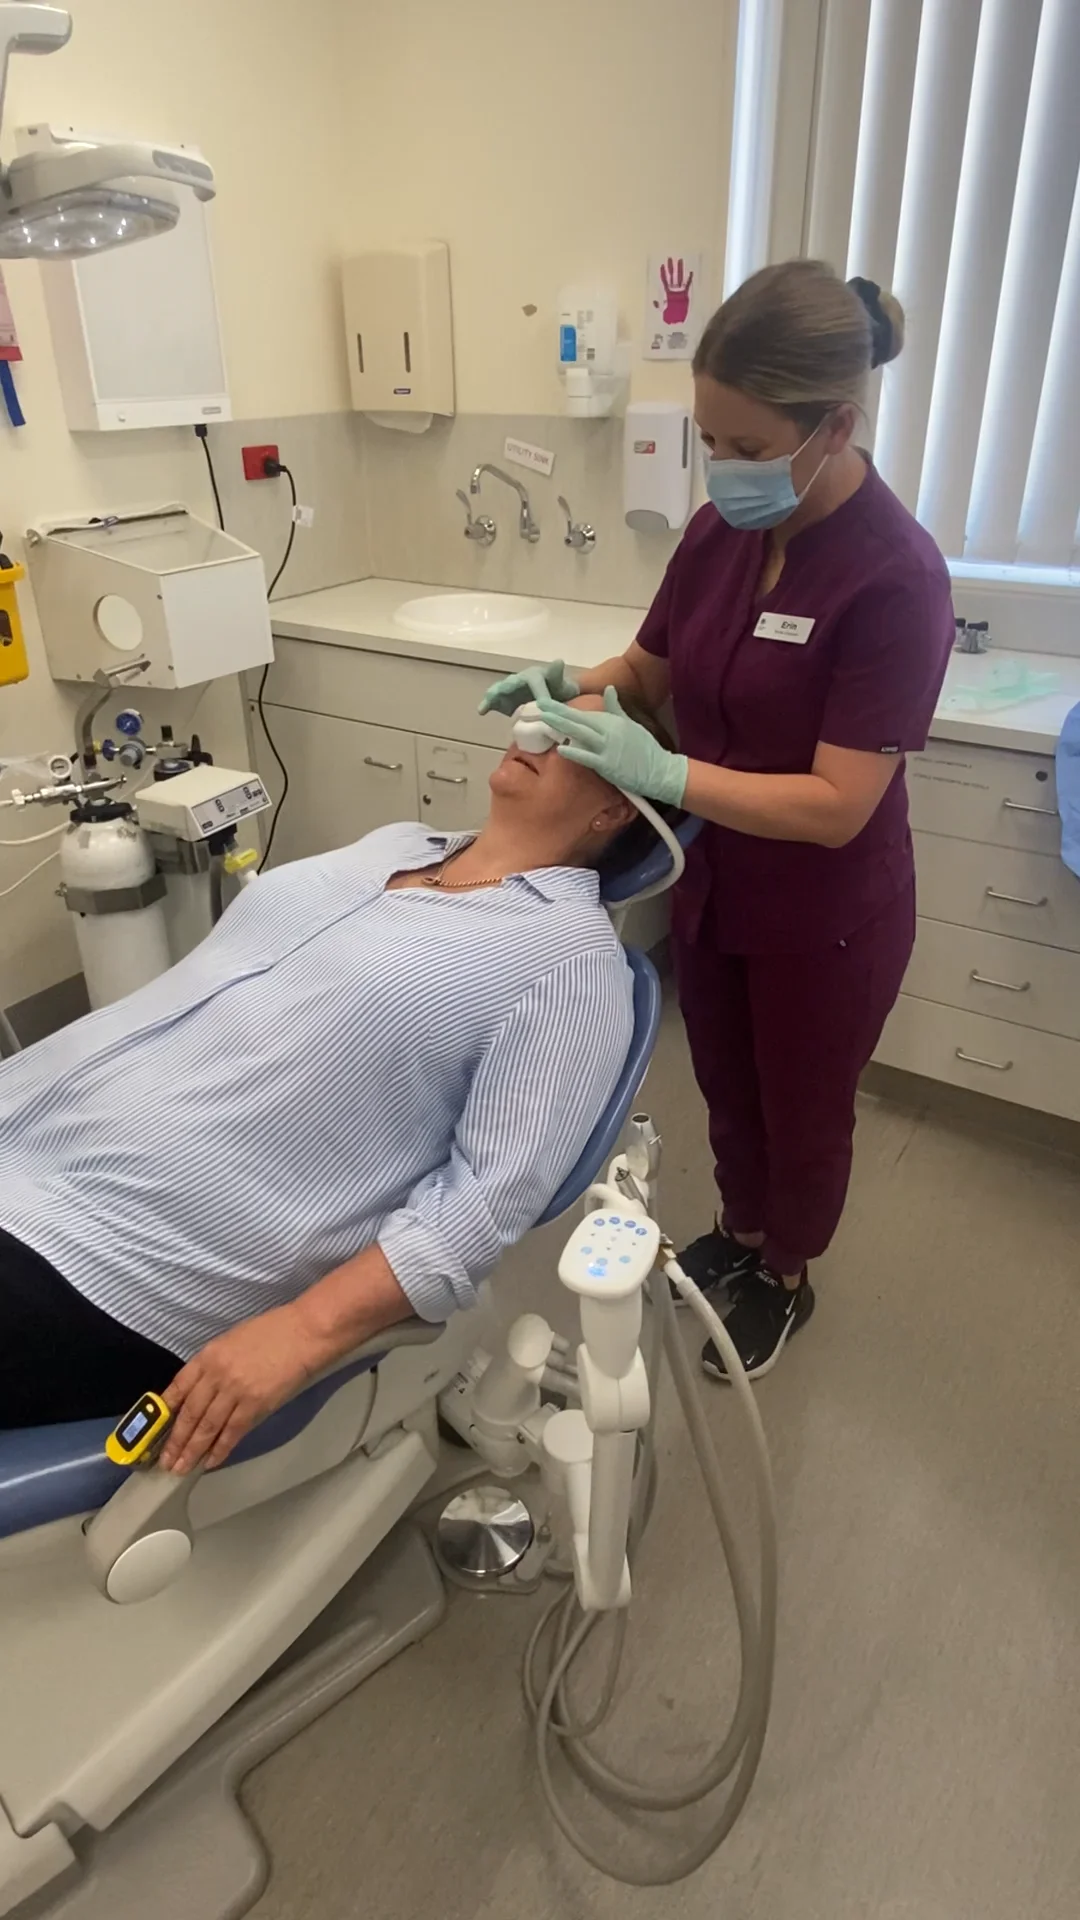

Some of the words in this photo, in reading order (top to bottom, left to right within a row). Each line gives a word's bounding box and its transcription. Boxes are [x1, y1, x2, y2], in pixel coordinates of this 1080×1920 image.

[507, 442, 532, 459] UTILITY
[533, 451, 549, 466] SINK
[781, 621, 798, 630] Erin
